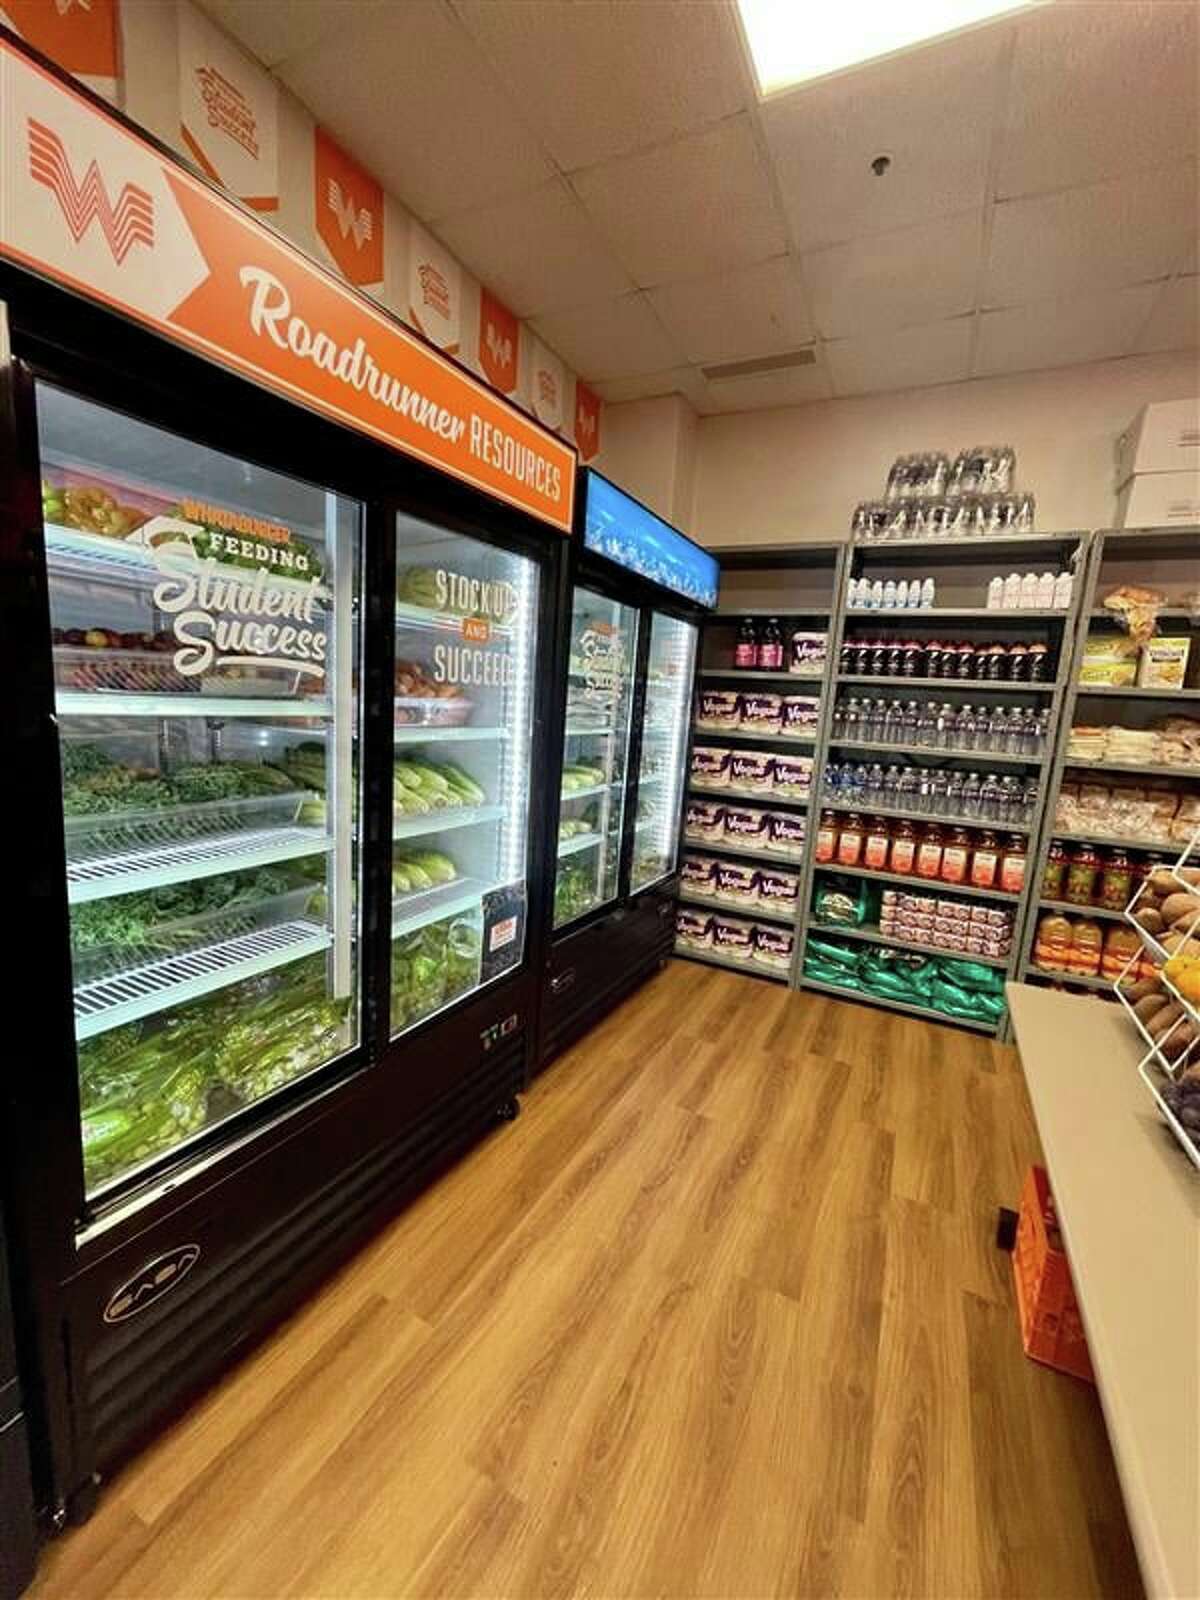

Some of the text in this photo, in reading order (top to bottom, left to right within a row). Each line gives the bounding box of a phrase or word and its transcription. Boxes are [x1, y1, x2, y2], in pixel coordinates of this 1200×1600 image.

[239, 266, 466, 443] Roadrunner
[469, 415, 561, 502] RESOURCES
[143, 516, 332, 623] Student
[209, 531, 310, 571] FEEDING
[435, 569, 490, 614] STOCK
[173, 611, 328, 677] Success
[434, 644, 515, 687] SUCCEED
